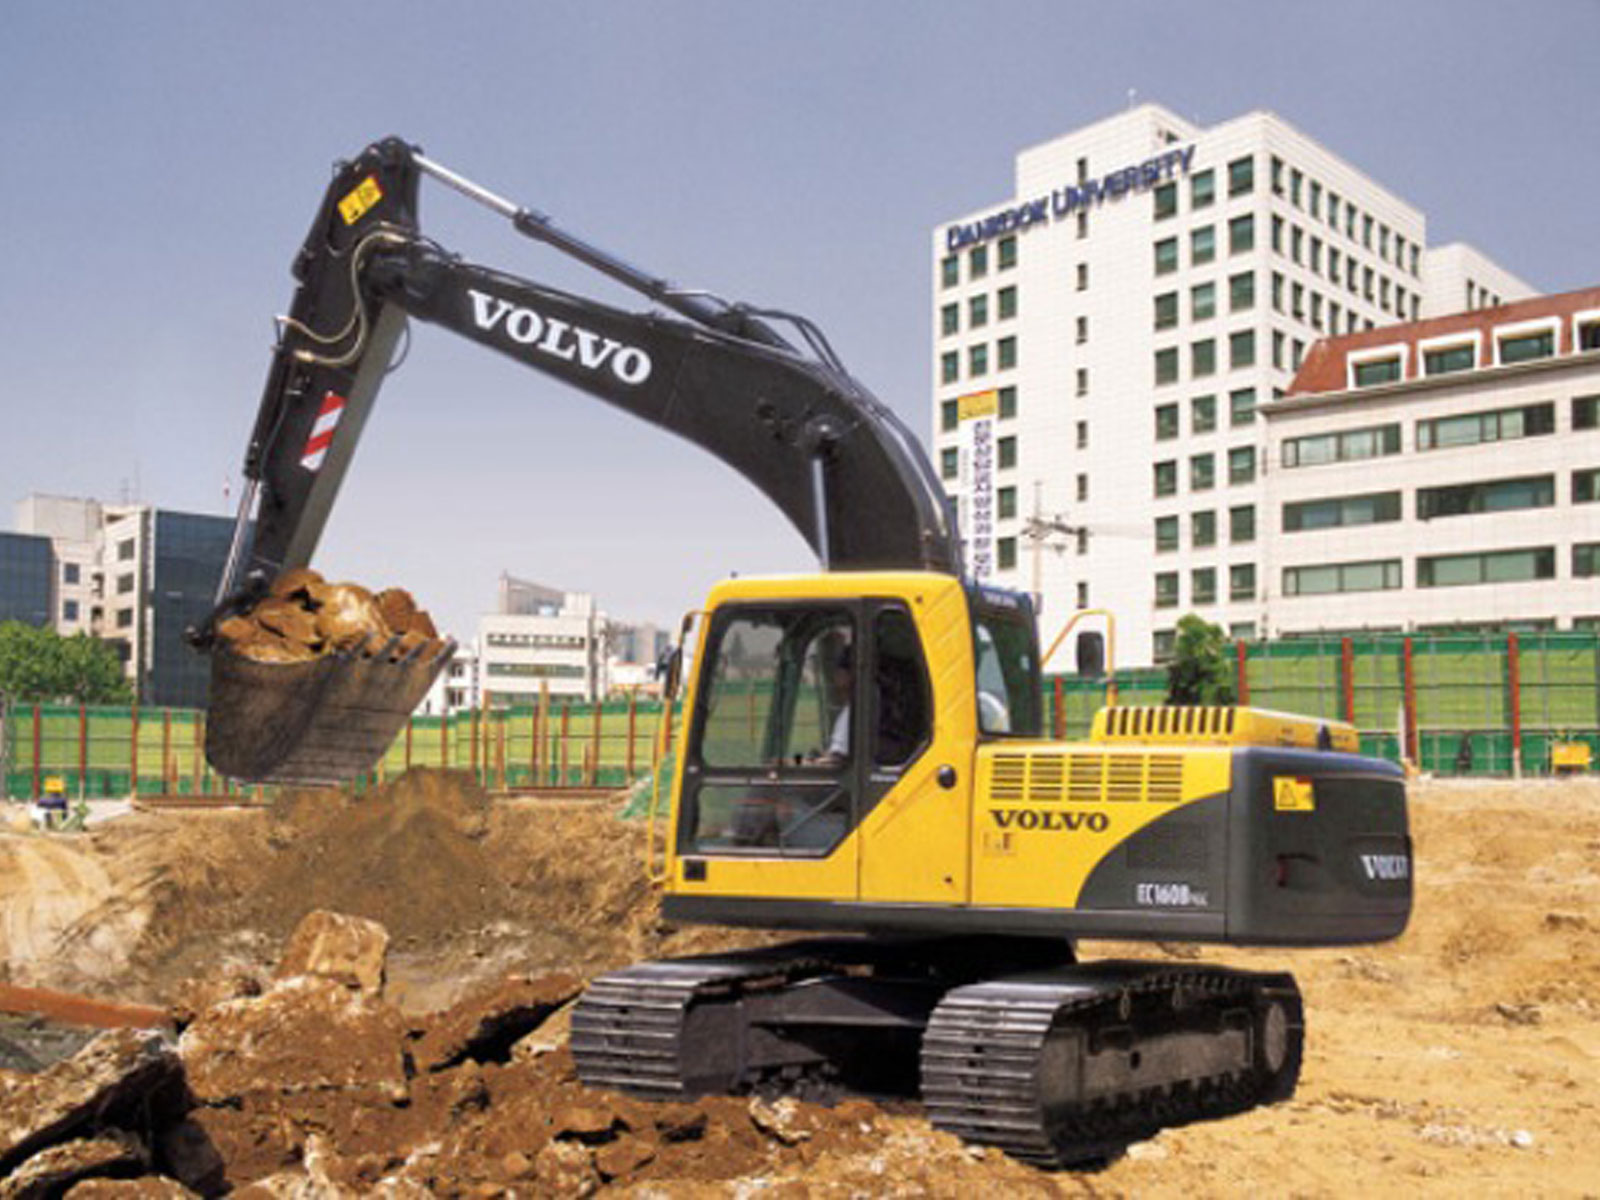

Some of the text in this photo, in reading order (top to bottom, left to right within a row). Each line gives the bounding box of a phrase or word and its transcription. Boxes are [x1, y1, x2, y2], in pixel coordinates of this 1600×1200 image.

[1052, 144, 1197, 217] UNIVERSITY
[467, 289, 652, 384] VOLVO
[990, 809, 1110, 833] VOLVO
